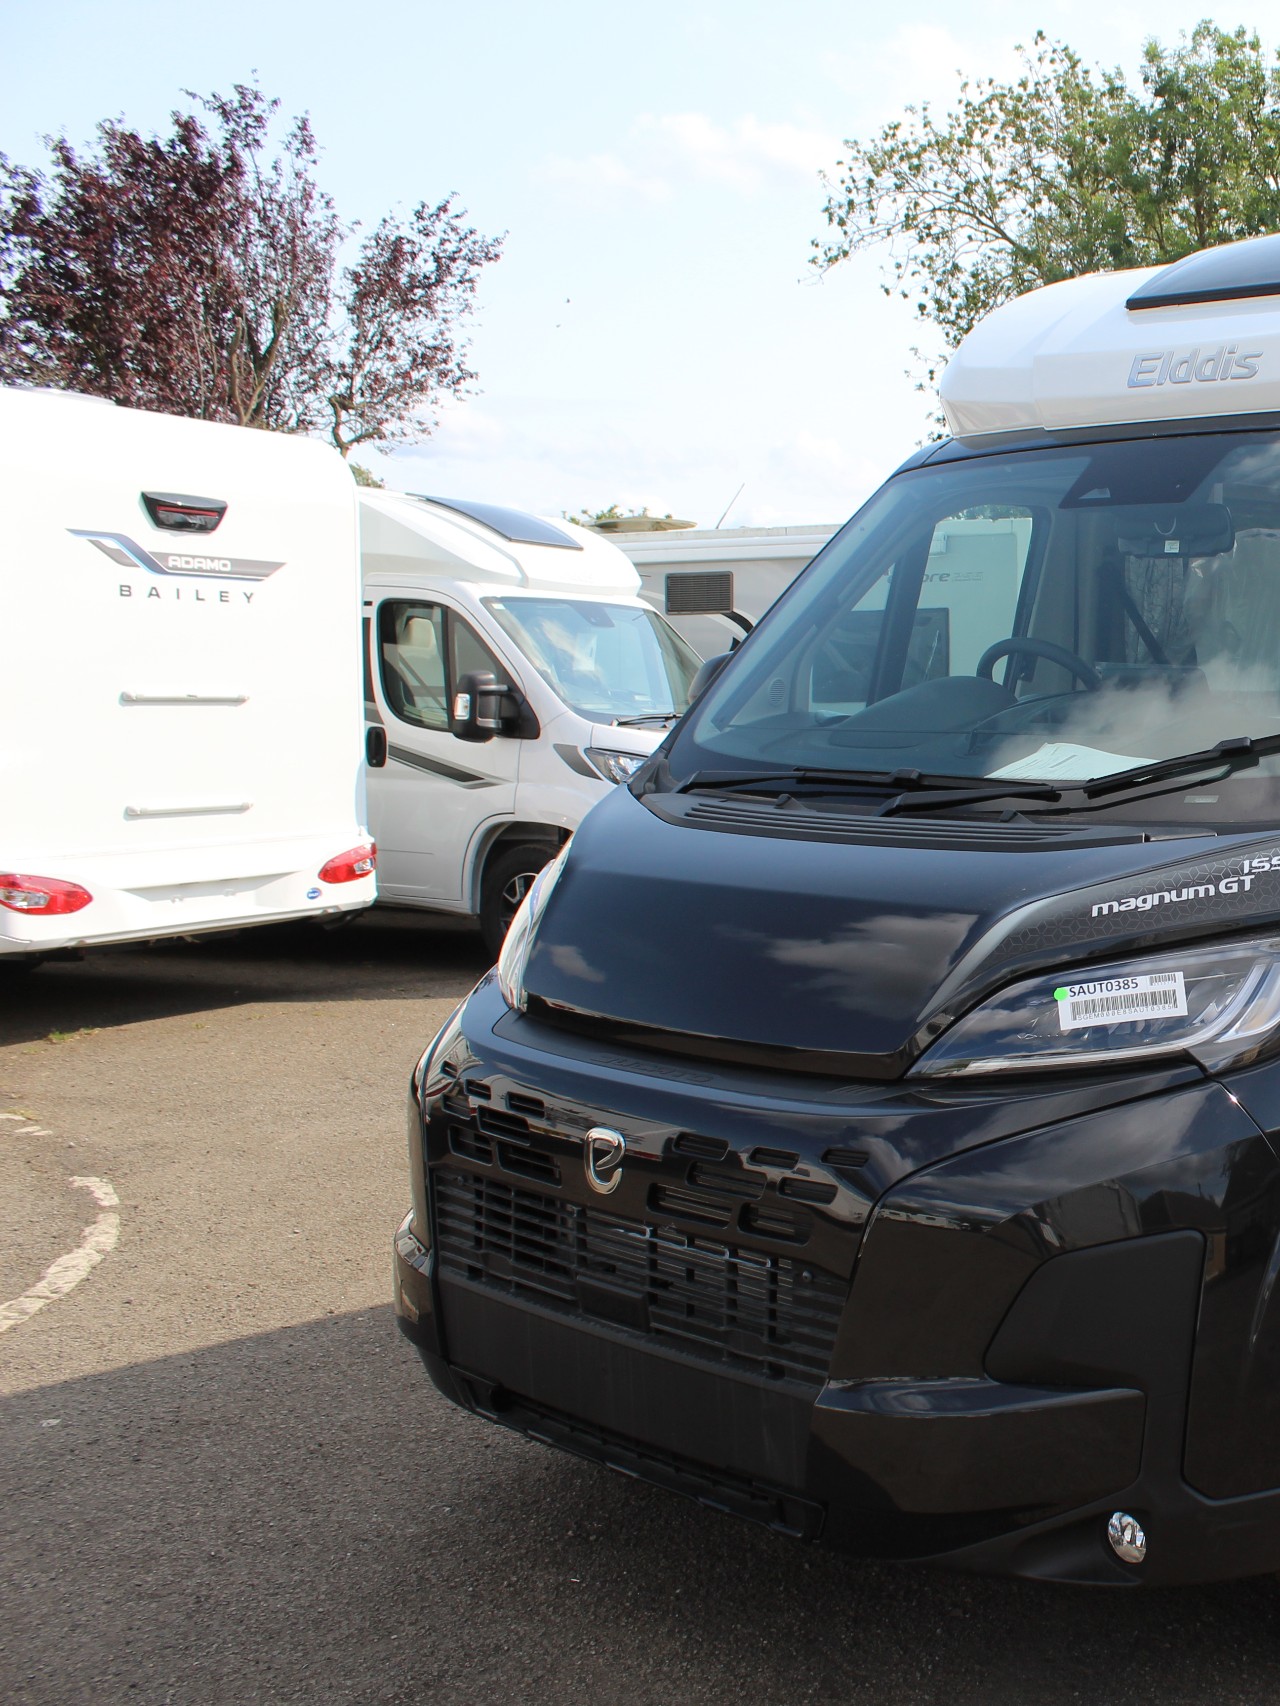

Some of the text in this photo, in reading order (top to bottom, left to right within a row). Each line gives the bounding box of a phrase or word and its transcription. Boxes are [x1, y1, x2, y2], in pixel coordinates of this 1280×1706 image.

[1127, 344, 1264, 388] Elddis
[168, 556, 231, 571] ADAMO
[119, 584, 254, 604] BAILEY
[1091, 875, 1256, 918] magnum GT
[1069, 978, 1139, 998] SAUT0385
